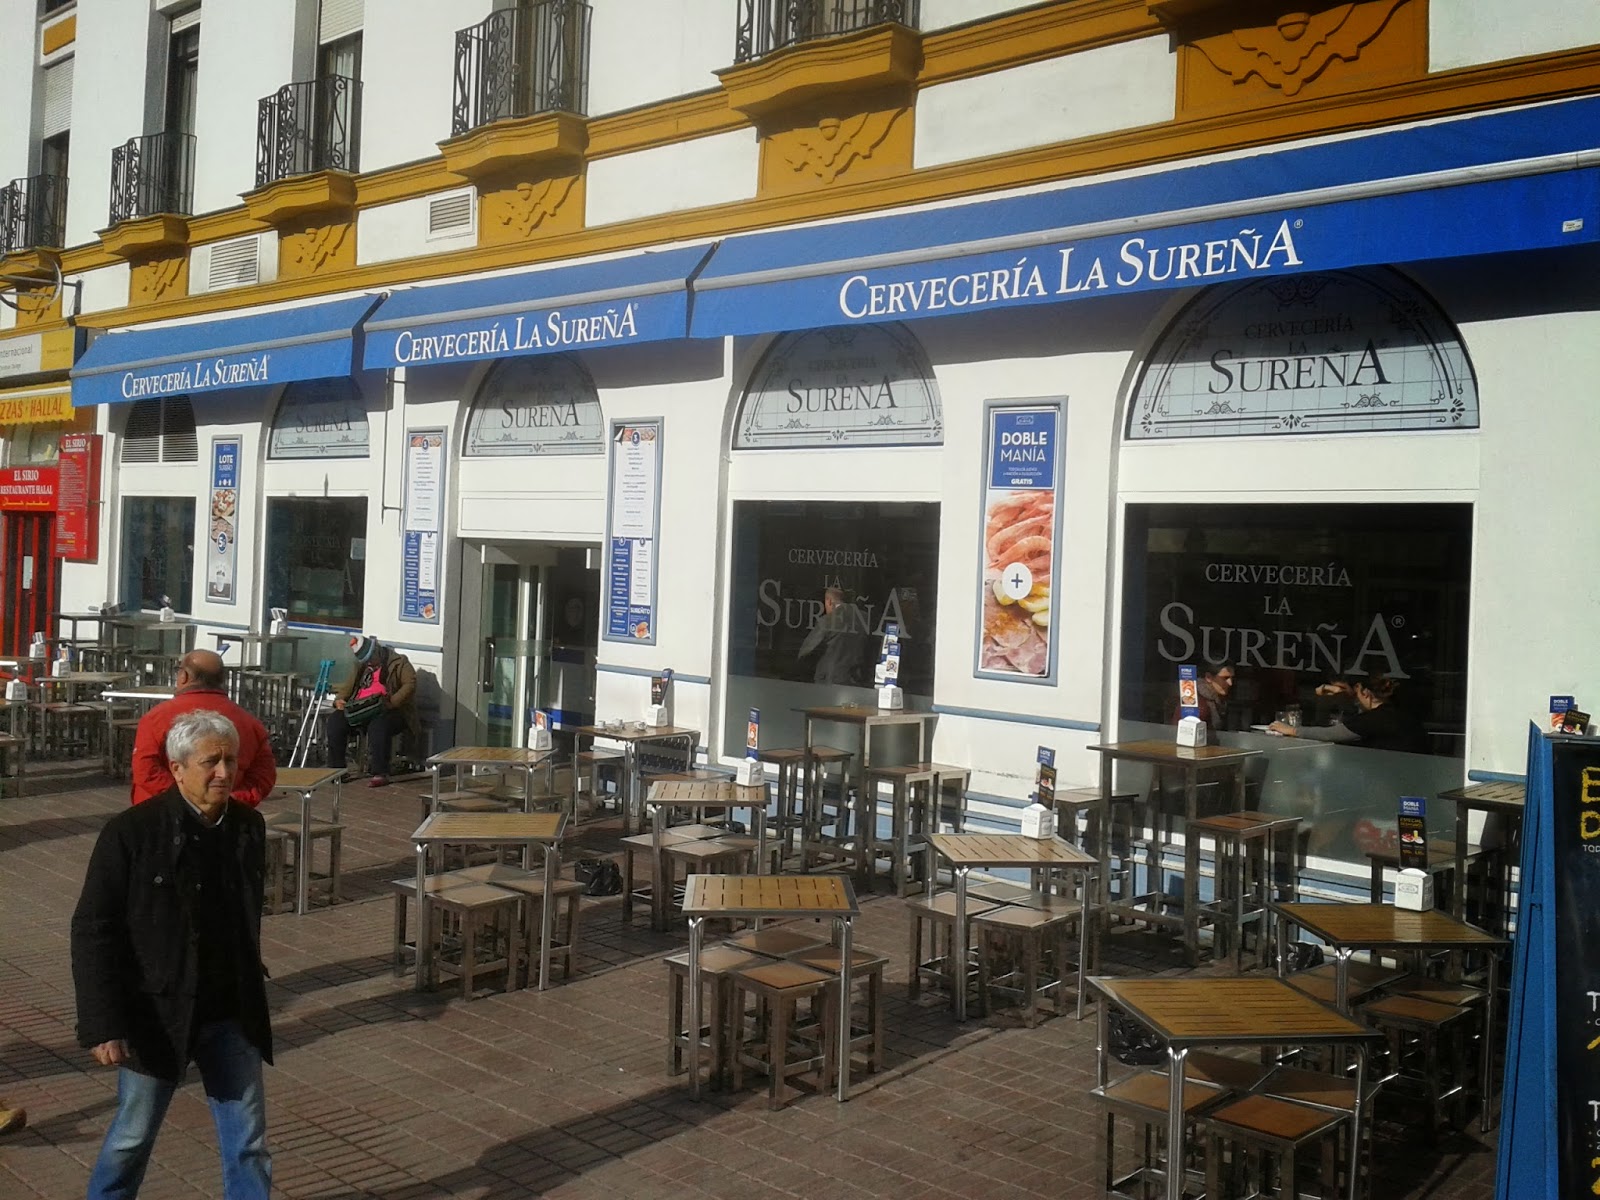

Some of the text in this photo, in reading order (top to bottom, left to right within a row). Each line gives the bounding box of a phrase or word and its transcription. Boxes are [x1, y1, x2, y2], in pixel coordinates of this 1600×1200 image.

[839, 218, 1303, 319] CERVECERÍA LA SUREÑA
[395, 302, 637, 363] CERVECERÍA LA SUREÑA
[122, 354, 268, 398] CERVECERÍA LA SUREÑA
[1001, 431, 1047, 446] DOBLE
[219, 454, 234, 464] LOTE
[1000, 446, 1046, 462] MANÍA
[14, 470, 21, 481] EL
[789, 549, 878, 568] CERVECERÍA
[823, 574, 842, 590] LA
[1205, 562, 1353, 587] CERVECERÍA
[757, 579, 912, 639] SUREÑA
[1263, 596, 1293, 616] LA
[1157, 601, 1411, 680] SUREÑA
